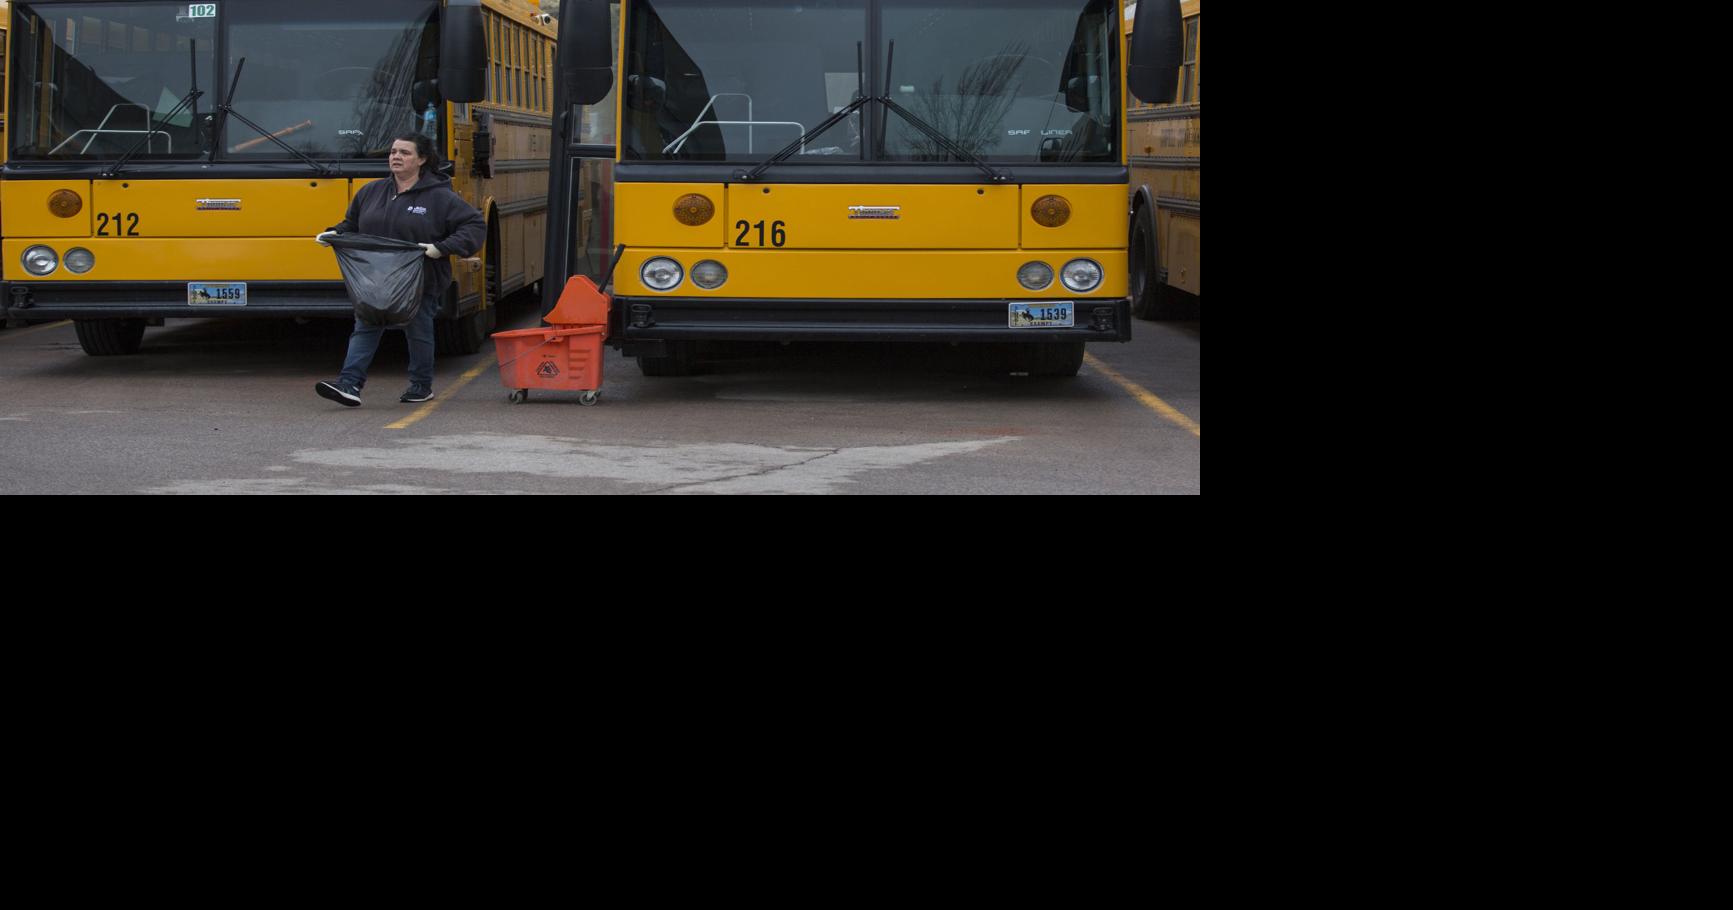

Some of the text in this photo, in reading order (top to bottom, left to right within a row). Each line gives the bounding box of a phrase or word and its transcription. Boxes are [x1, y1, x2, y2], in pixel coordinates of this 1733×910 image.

[190, 5, 214, 16] 102
[96, 212, 140, 236] 212
[735, 219, 786, 247] 216
[216, 288, 240, 299] 1559
[1040, 308, 1067, 320] 1539
